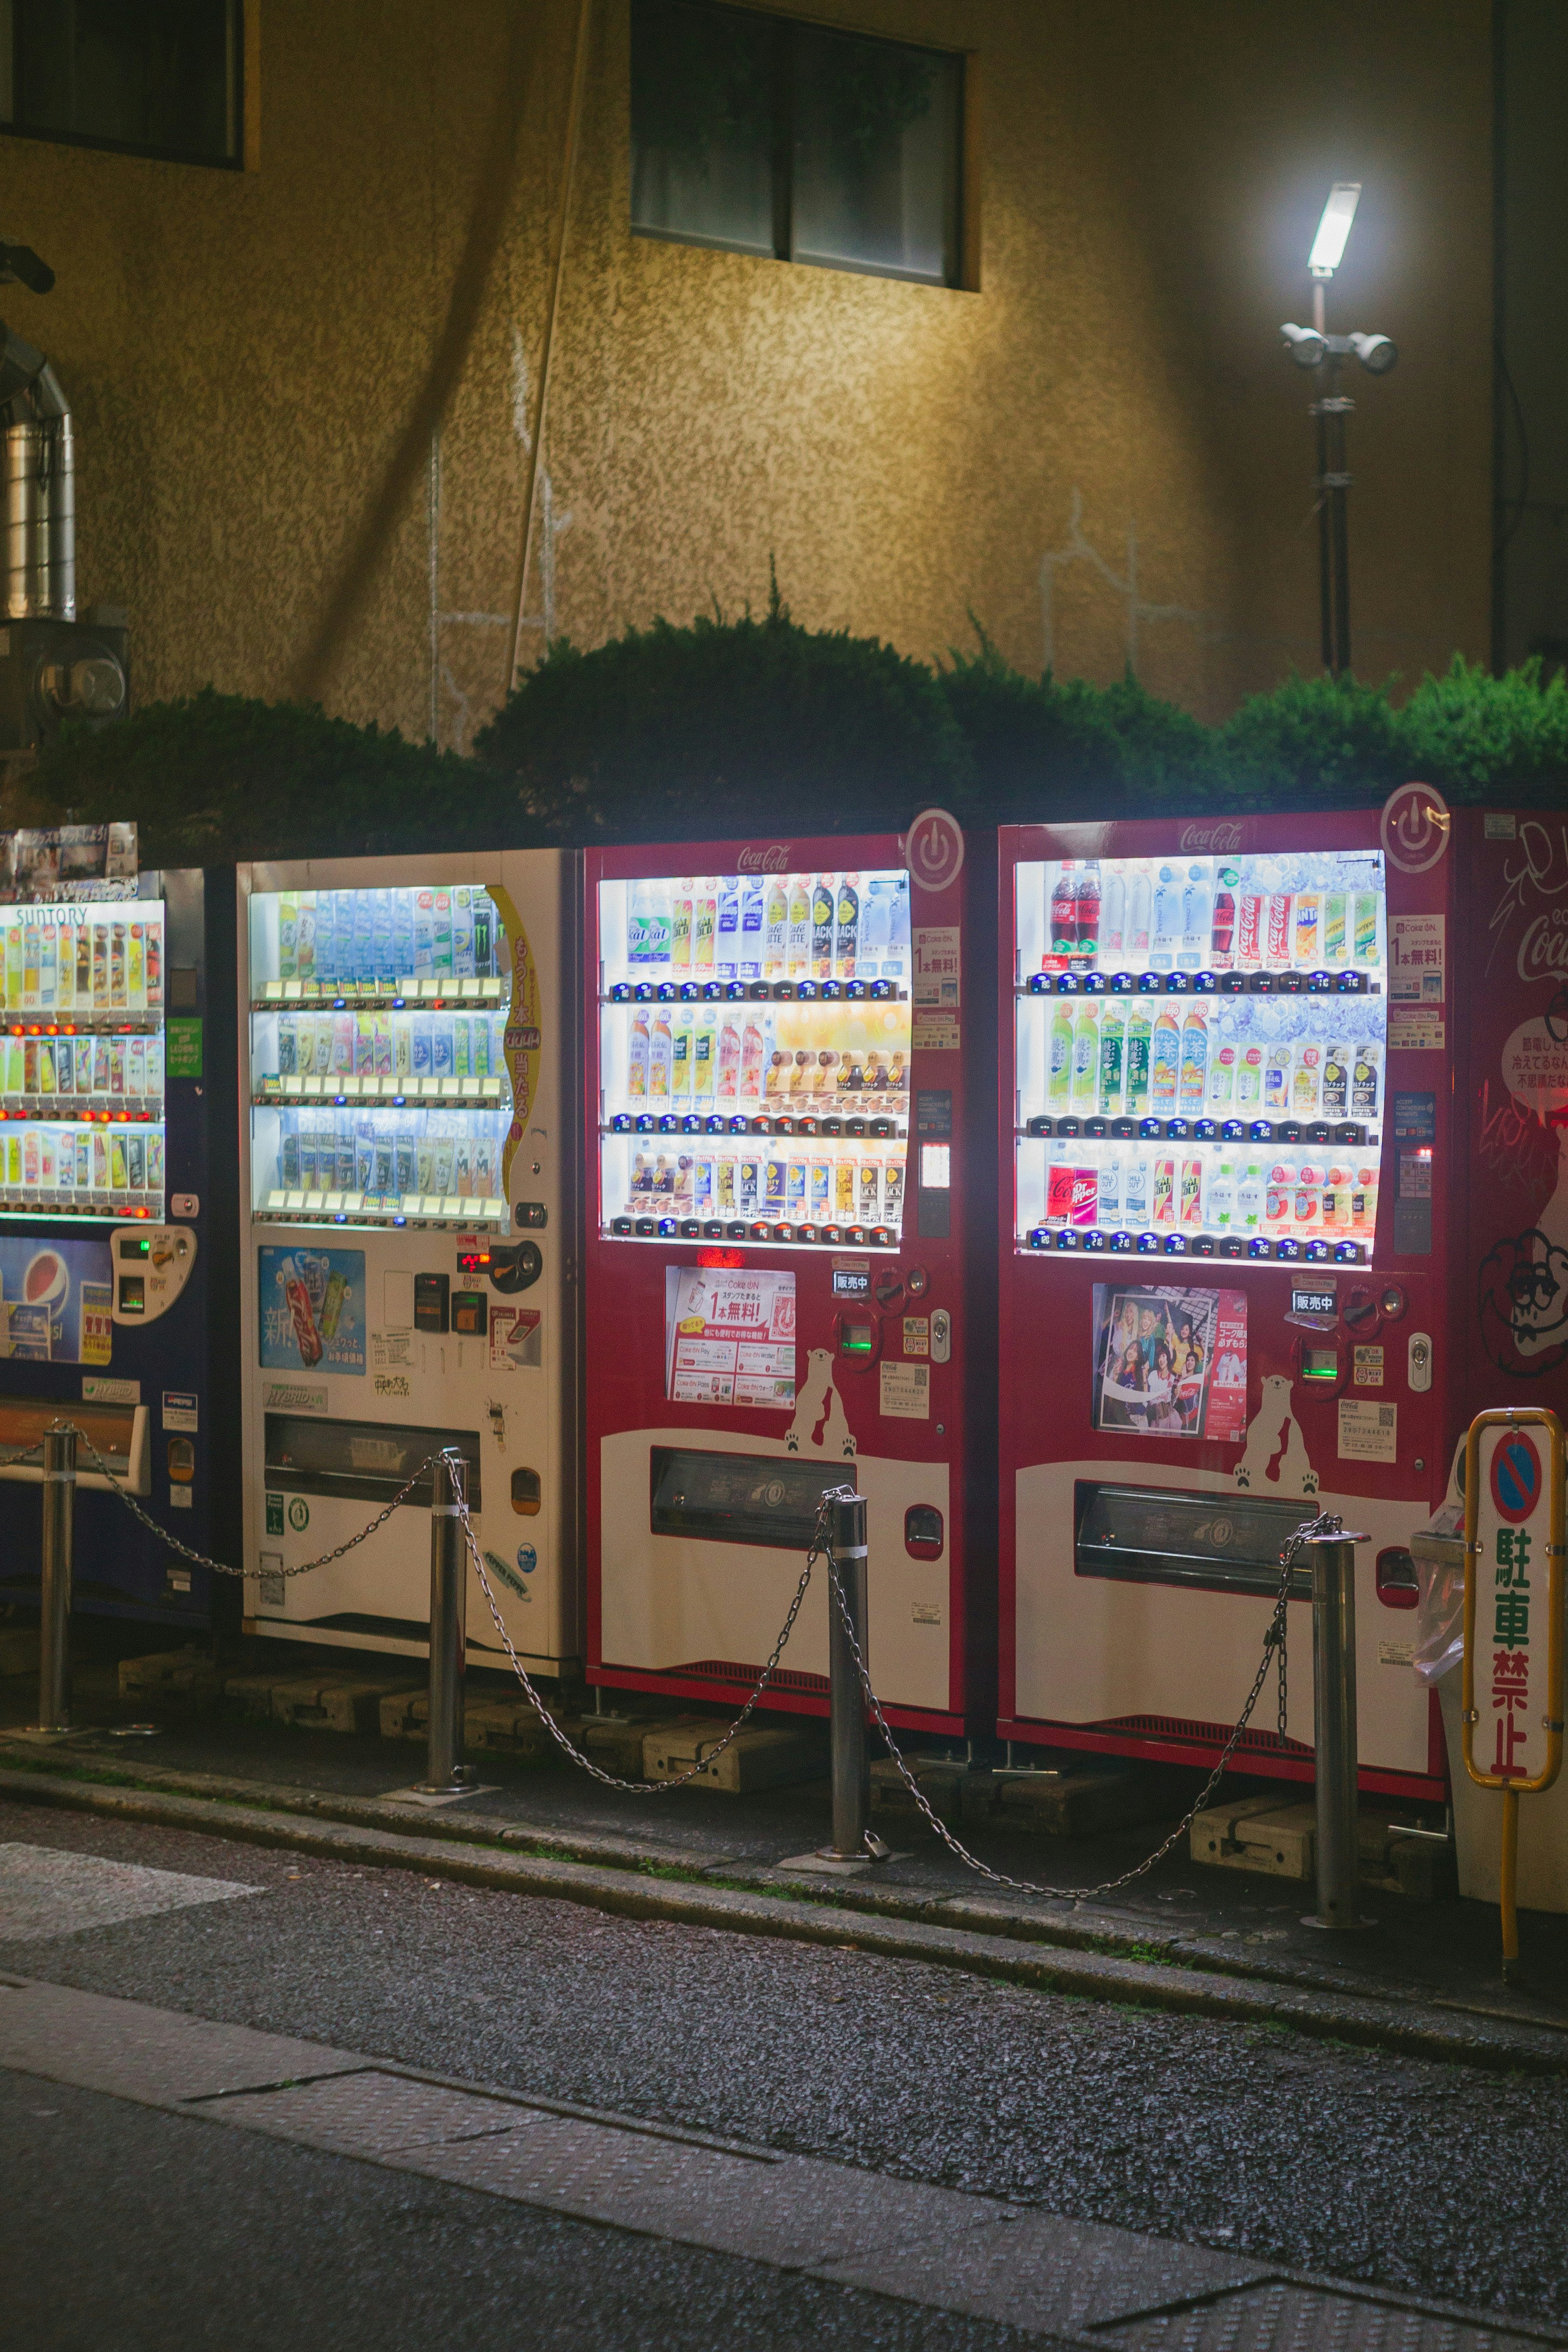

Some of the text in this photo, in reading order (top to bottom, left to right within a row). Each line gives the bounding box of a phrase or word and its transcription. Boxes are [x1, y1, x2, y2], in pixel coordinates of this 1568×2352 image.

[1180, 823, 1243, 851] Coca-Cola
[737, 845, 790, 871] Coca-Cola
[17, 907, 87, 926] SUNTORY
[1405, 924, 1424, 933] Coke
[1076, 1183, 1087, 1193] Dr
[728, 1280, 746, 1289] Coke
[837, 1276, 868, 1290] 販売中
[723, 1292, 761, 1301] スタンプたまると
[1297, 1295, 1333, 1310] 販売中
[711, 1291, 761, 1322] 1本無料!
[1218, 1337, 1247, 1349] 必ずもら
[1490, 1527, 1532, 1777] 駐車禁止
